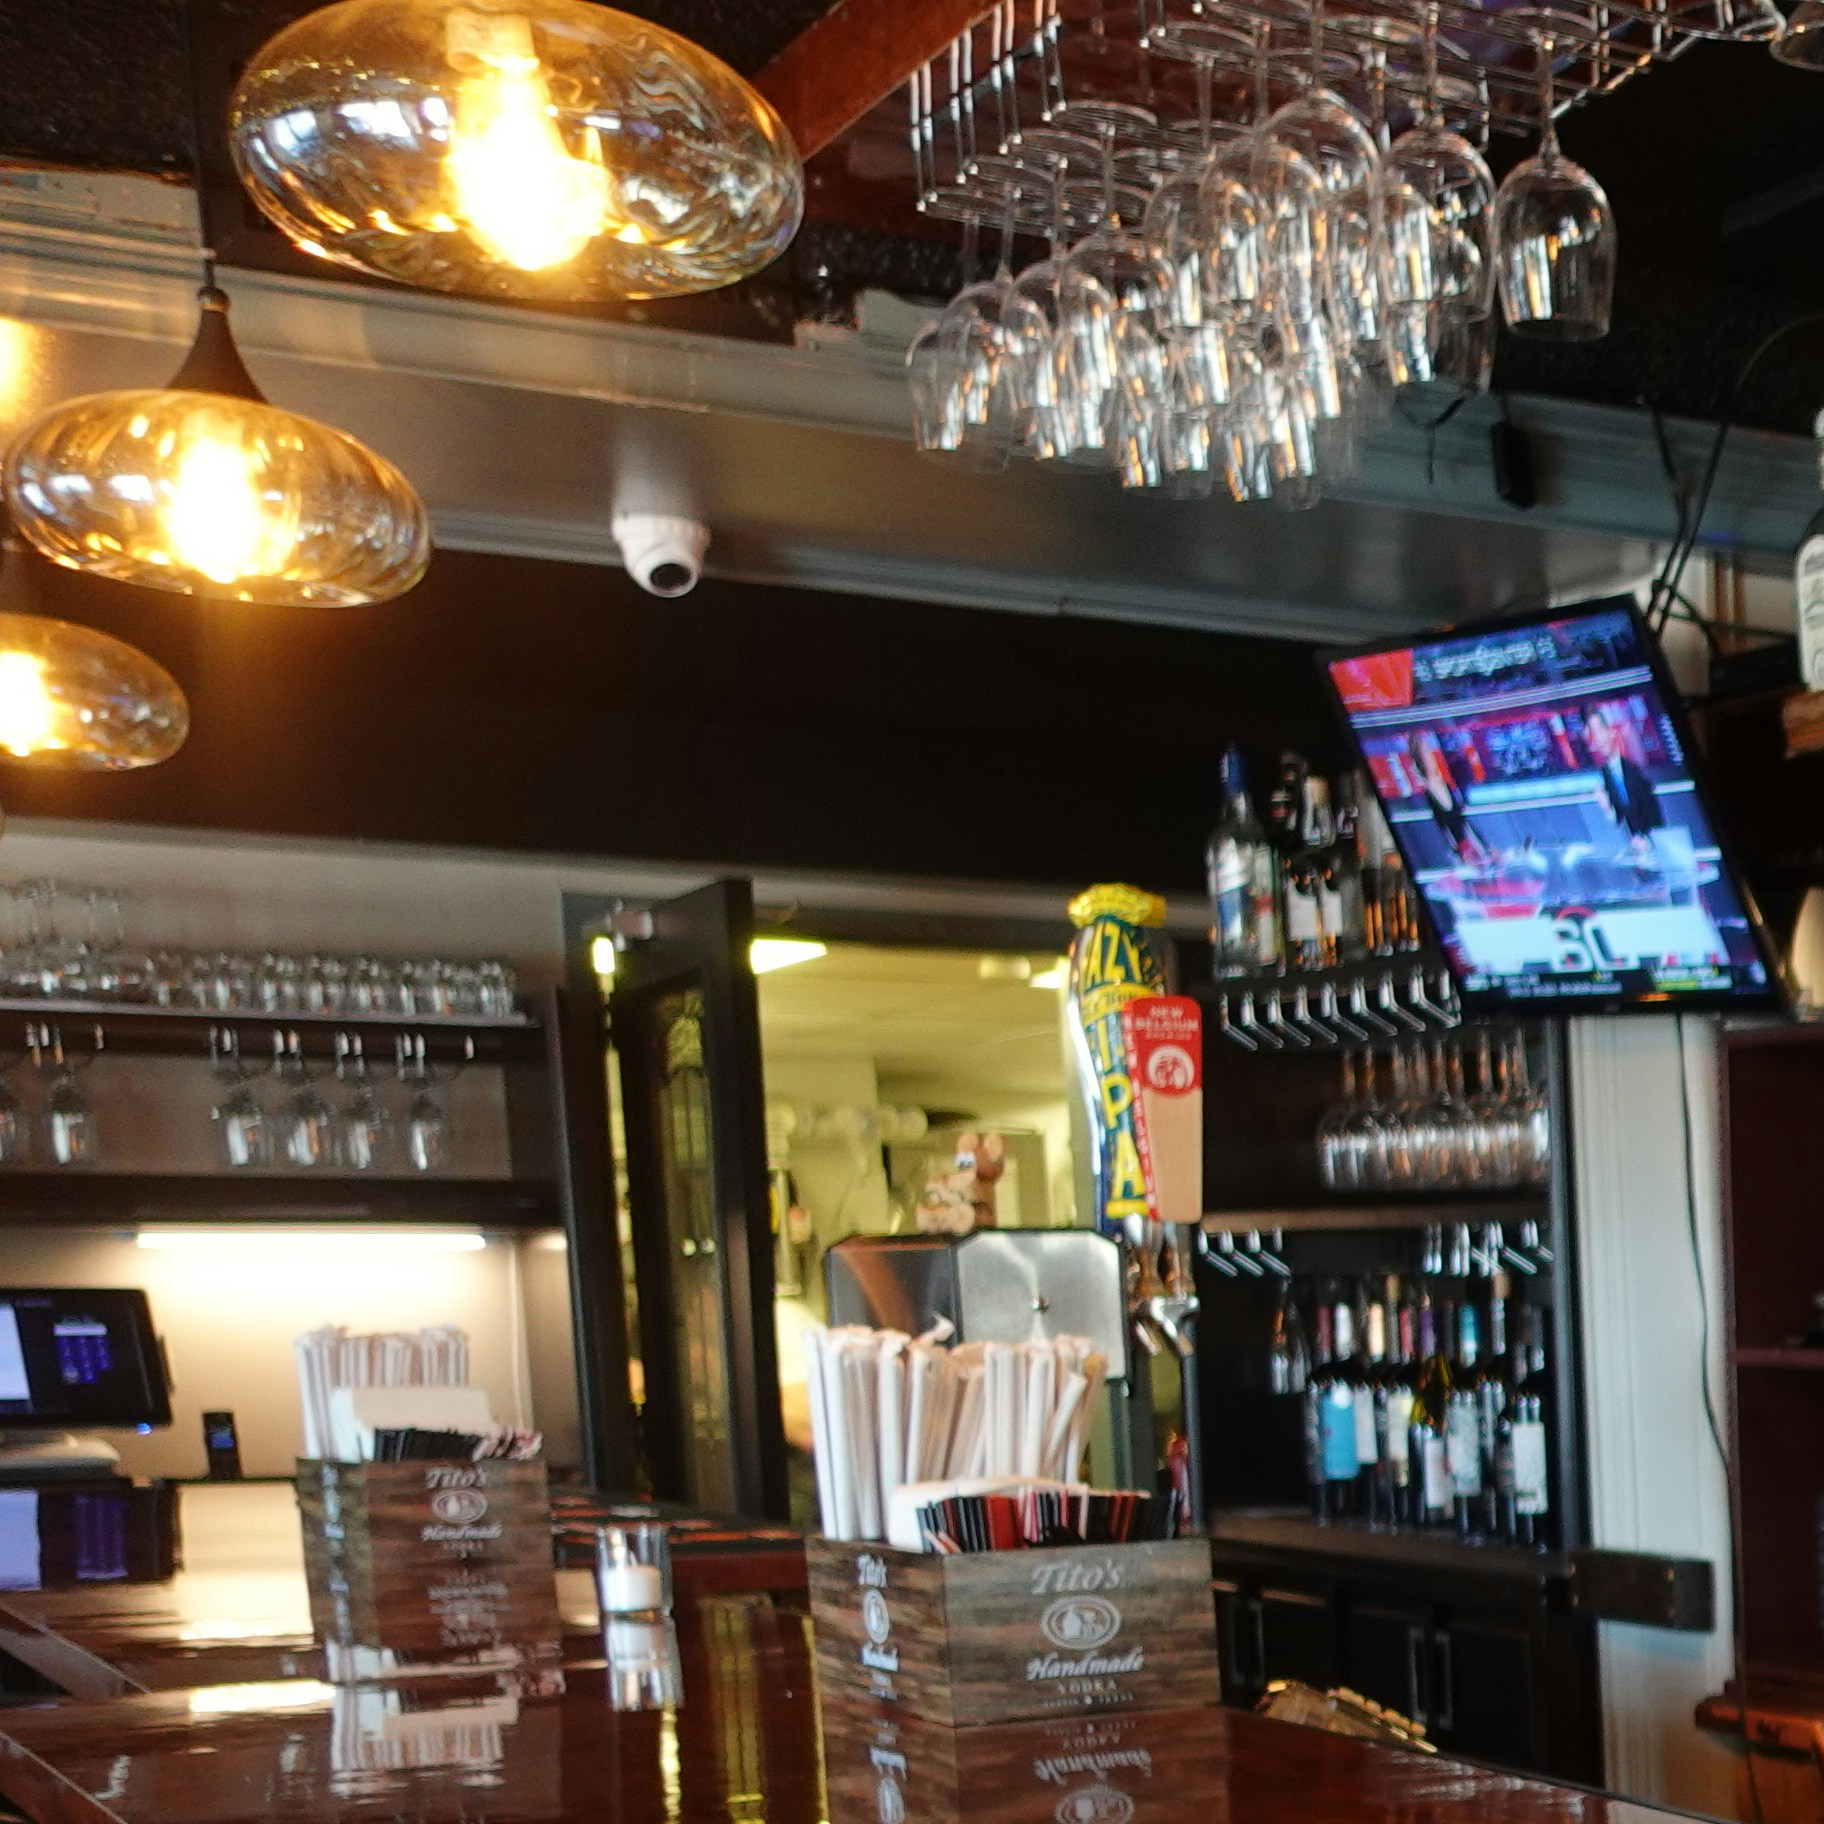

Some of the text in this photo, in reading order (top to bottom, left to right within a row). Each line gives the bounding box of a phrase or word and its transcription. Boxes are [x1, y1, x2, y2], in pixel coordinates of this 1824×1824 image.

[1079, 921, 1144, 992] AZY
[1031, 1559, 1127, 1595] Tito's
[1026, 1646, 1145, 1681] Handmade
